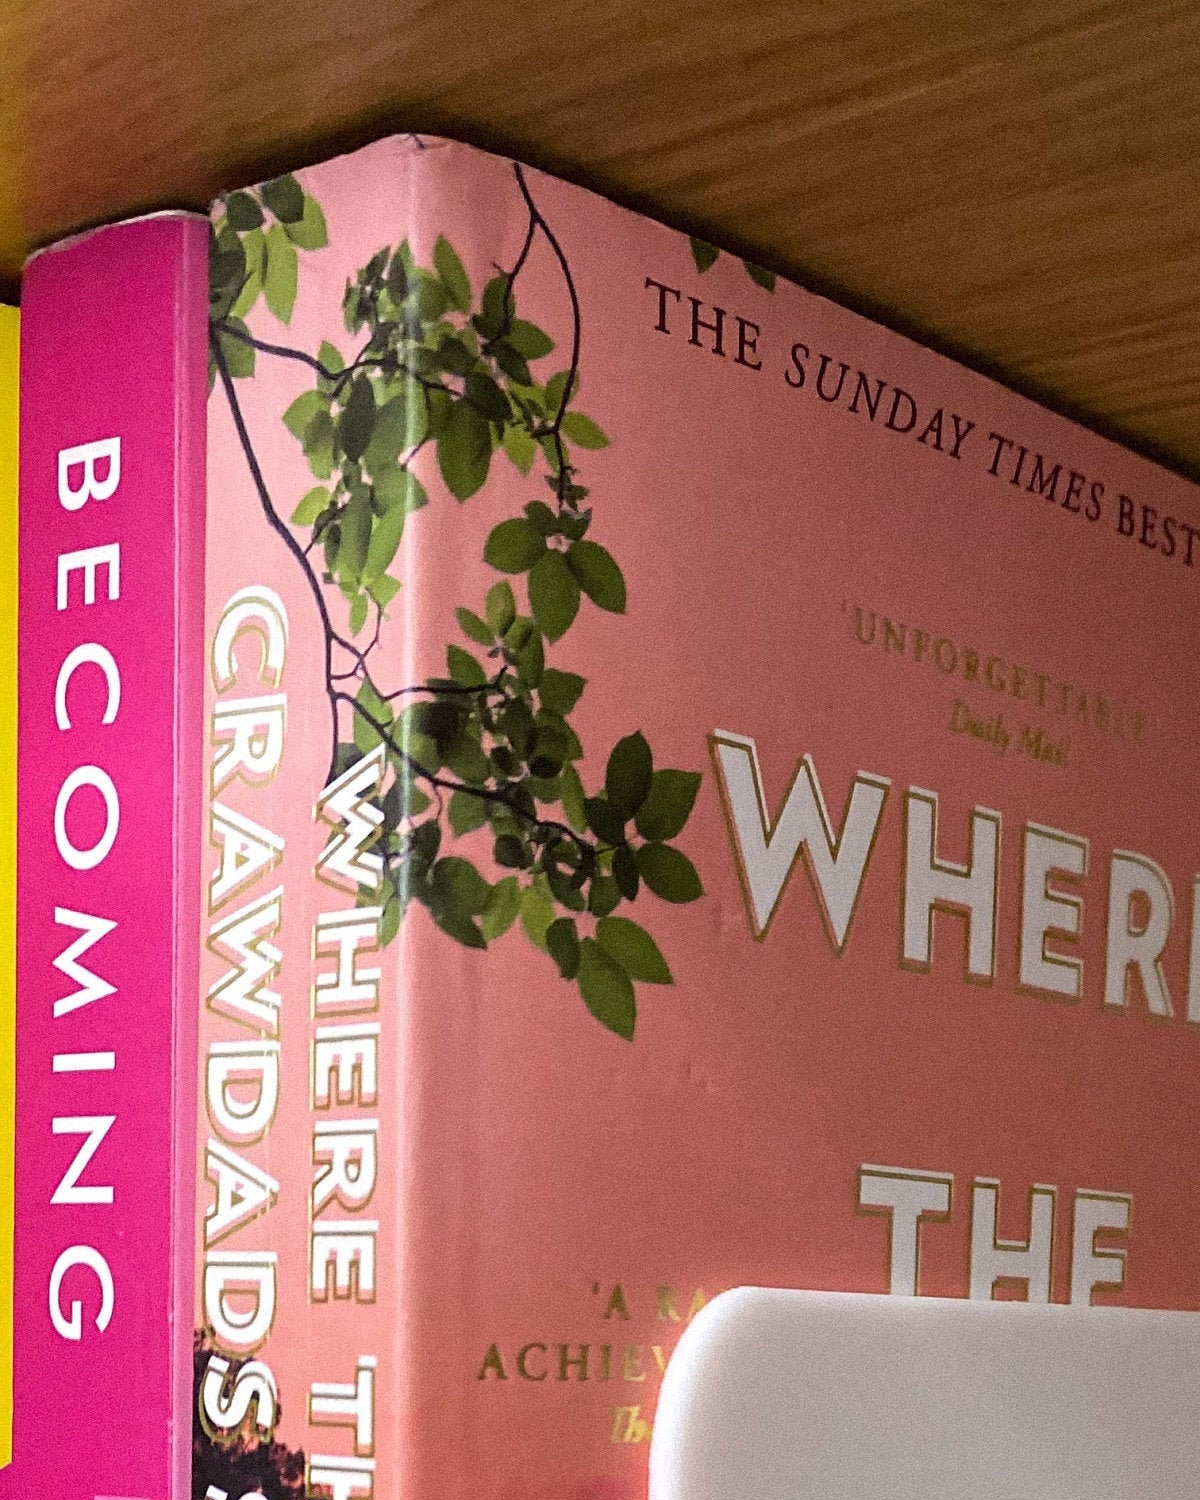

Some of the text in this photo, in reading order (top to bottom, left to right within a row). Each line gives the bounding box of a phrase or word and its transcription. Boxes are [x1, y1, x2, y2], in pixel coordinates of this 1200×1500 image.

[645, 276, 763, 371] THE
[784, 343, 976, 460] SUNDAY
[987, 432, 1105, 522] TIMES
[48, 436, 122, 1341] BECOMING
[198, 584, 290, 1444] CRAWDADS
[311, 743, 386, 1304] WHERE
